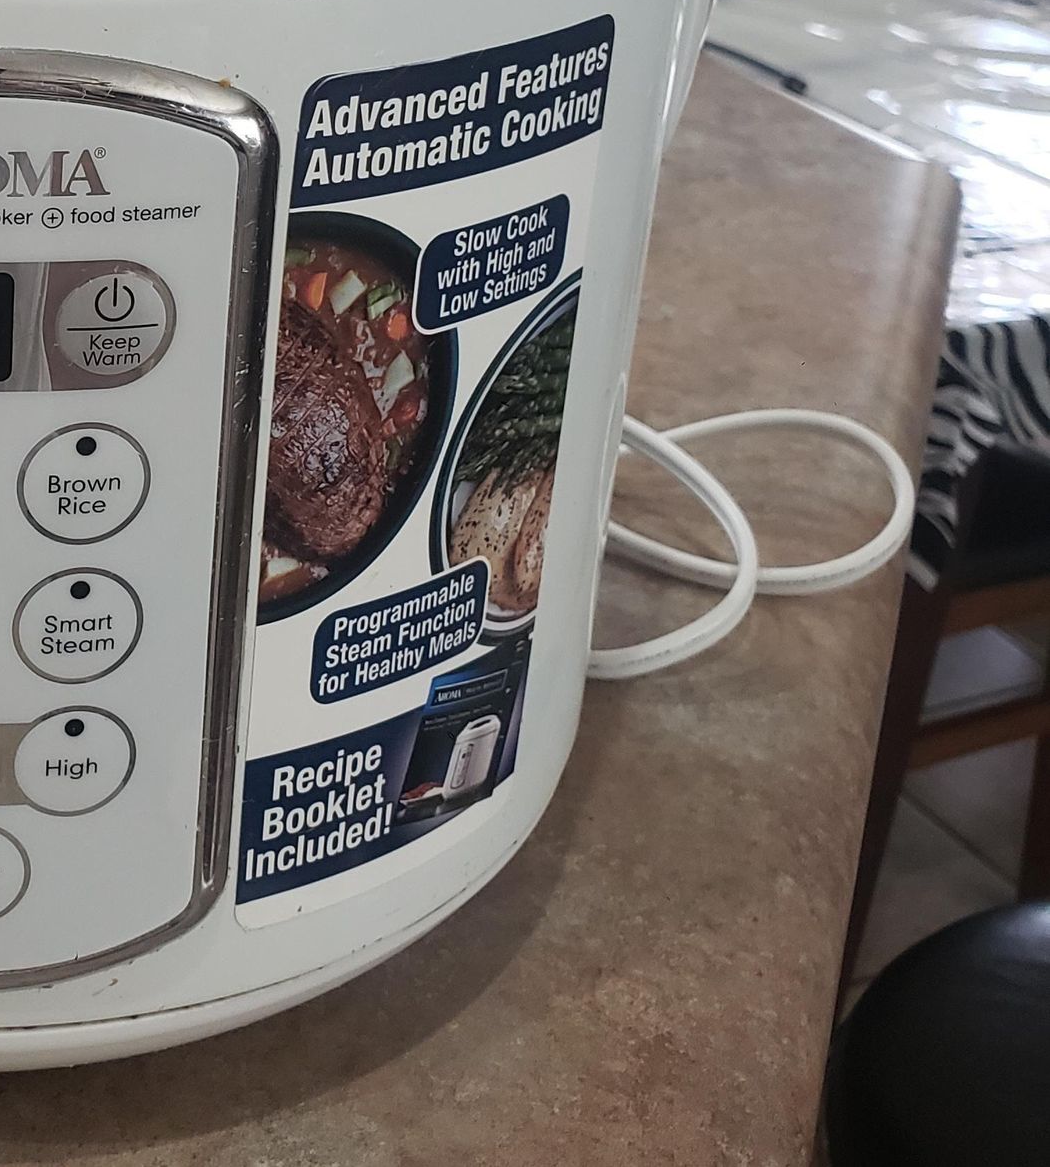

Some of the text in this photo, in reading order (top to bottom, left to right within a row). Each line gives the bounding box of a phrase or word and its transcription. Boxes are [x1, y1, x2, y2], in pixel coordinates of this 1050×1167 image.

[305, 42, 609, 140] Advanced Features
[302, 86, 603, 188] Automatic Cooking
[70, 206, 115, 225] food
[121, 203, 202, 222] steamer
[454, 205, 549, 257] Slow Cook
[437, 227, 556, 290] with High and
[440, 263, 547, 318] Low Settings
[82, 349, 142, 367] Warm
[89, 333, 141, 352] Keep
[47, 474, 121, 494] Brown
[57, 496, 107, 515] Rice
[44, 613, 113, 634] Smart
[325, 598, 476, 669] Steam Function
[333, 574, 475, 641] Programmable
[40, 636, 116, 655] Steam
[318, 620, 477, 697] for Healthy Meals
[45, 758, 98, 780] High
[271, 744, 383, 802] Recipe
[261, 773, 387, 842] Booklet
[245, 803, 394, 882] Included!
